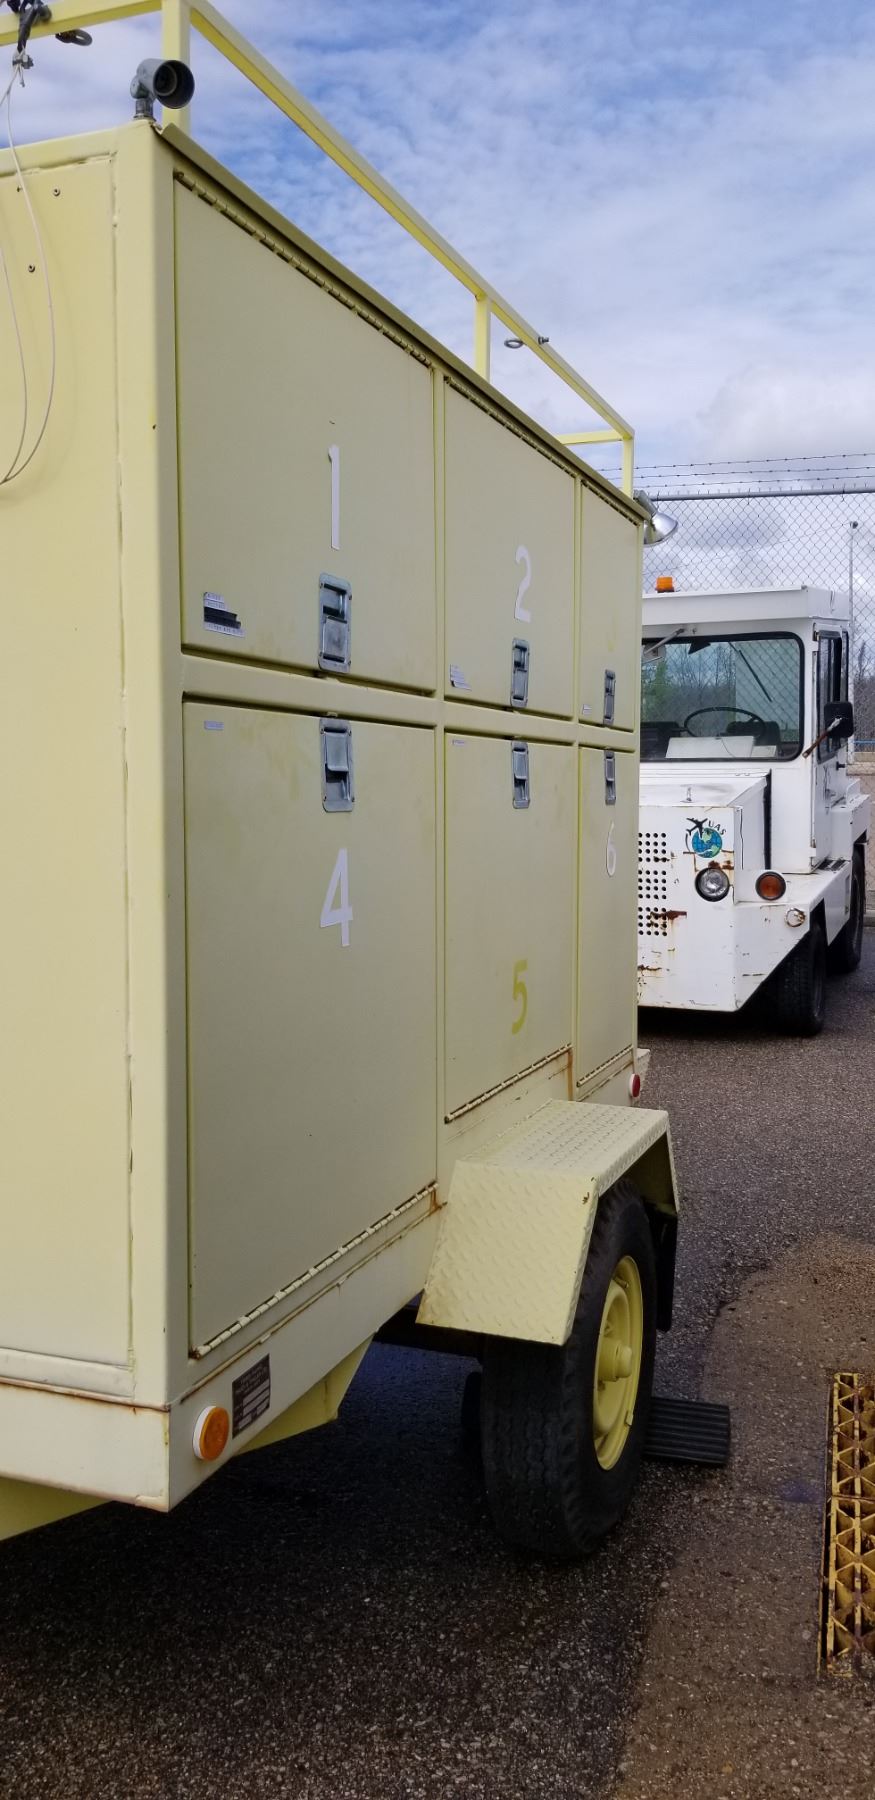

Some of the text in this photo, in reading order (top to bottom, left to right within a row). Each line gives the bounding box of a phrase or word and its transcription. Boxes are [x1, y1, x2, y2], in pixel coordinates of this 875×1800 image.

[327, 445, 341, 551] 1
[514, 544, 532, 624] 2
[605, 821, 618, 877] 6
[708, 820, 727, 836] UAS
[320, 847, 354, 947] 4
[510, 961, 529, 1034] 5
